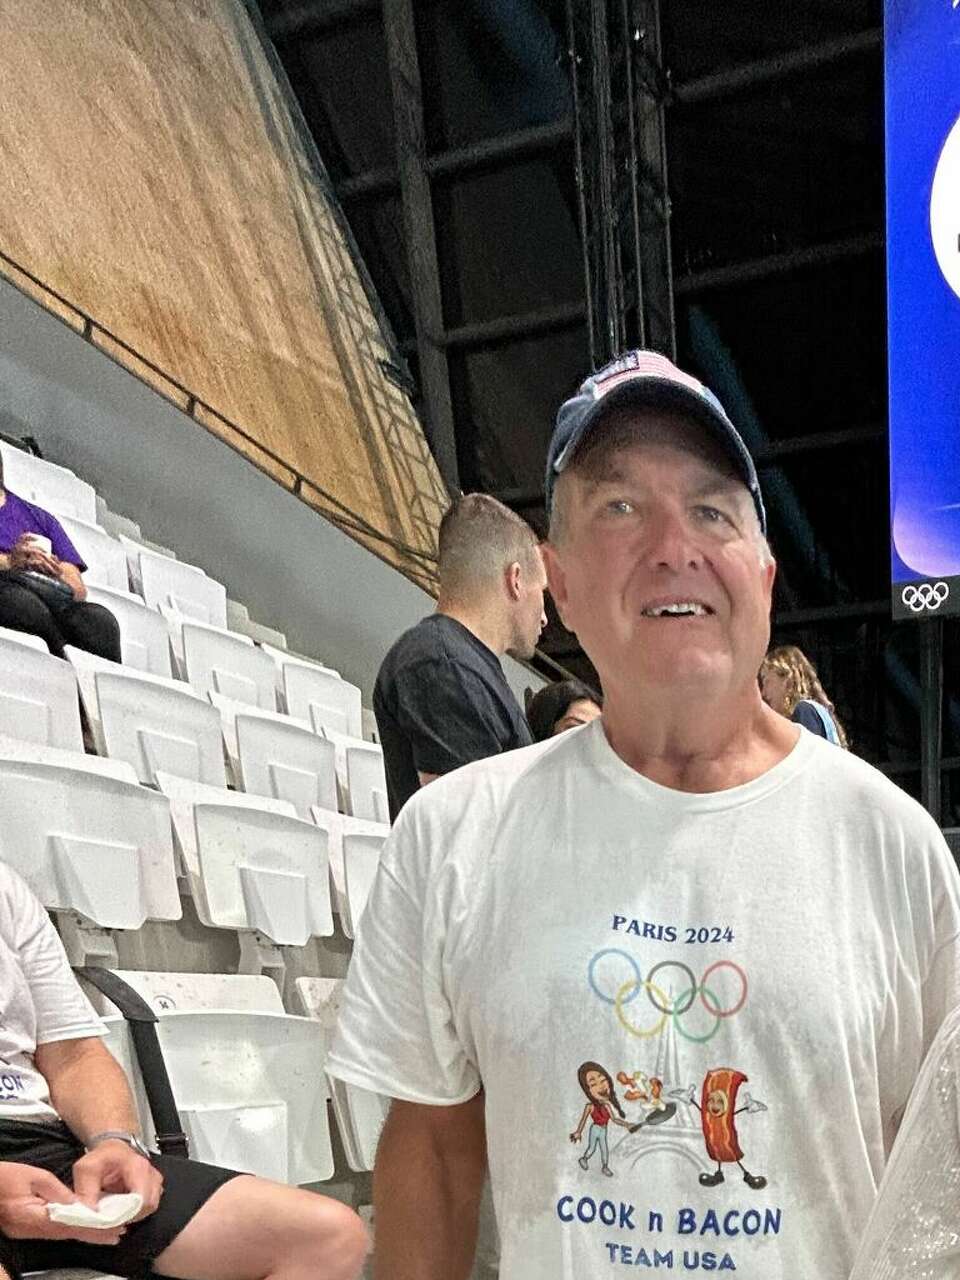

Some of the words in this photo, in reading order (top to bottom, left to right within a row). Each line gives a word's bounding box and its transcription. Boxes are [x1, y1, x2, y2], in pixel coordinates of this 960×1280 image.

[612, 914, 678, 943] PARIS
[684, 925, 735, 945] 2024
[556, 1195, 637, 1231] COOK
[647, 1210, 664, 1233] n
[676, 1207, 783, 1237] BACON
[605, 1242, 674, 1269] TEAM
[682, 1250, 737, 1272] USA
